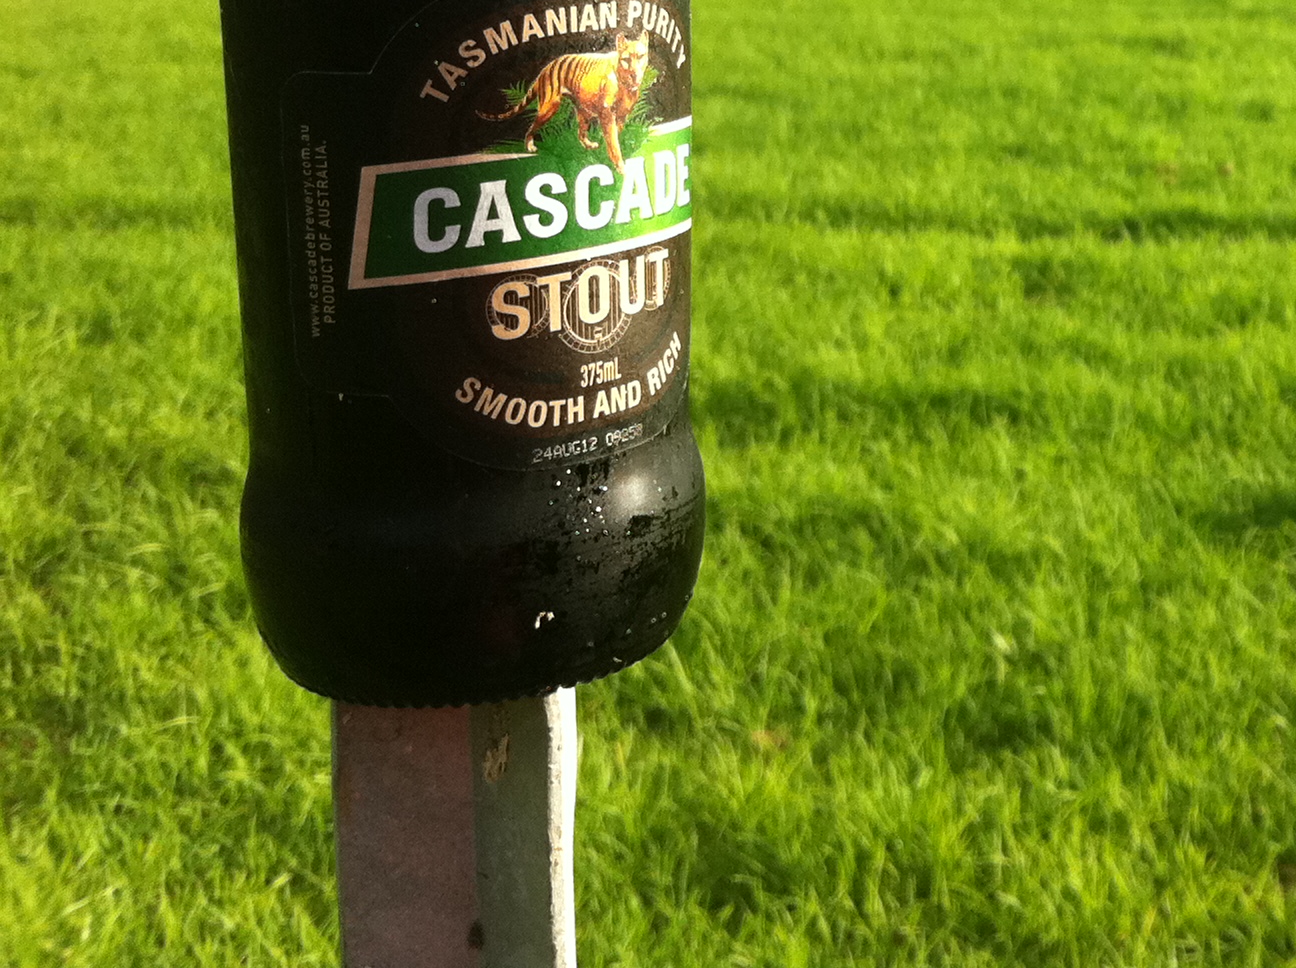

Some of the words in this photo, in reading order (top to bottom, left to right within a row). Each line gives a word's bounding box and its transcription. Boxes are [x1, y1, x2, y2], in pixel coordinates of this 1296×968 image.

[419, 0, 617, 103] TASMANIAN
[626, 0, 687, 69] PURITY
[315, 140, 330, 228] AUSTRALIA.
[413, 143, 691, 254] CASCADE
[301, 125, 321, 338] www.cascadebrewery.com.au
[319, 232, 333, 251] OF
[320, 254, 336, 324] PRODUCT
[491, 248, 669, 340] STOUT
[455, 377, 585, 428] SMOOTH
[593, 379, 642, 419] AND
[646, 331, 682, 396] RICH
[580, 357, 622, 387] 375mL
[532, 436, 599, 464] 24AUG12
